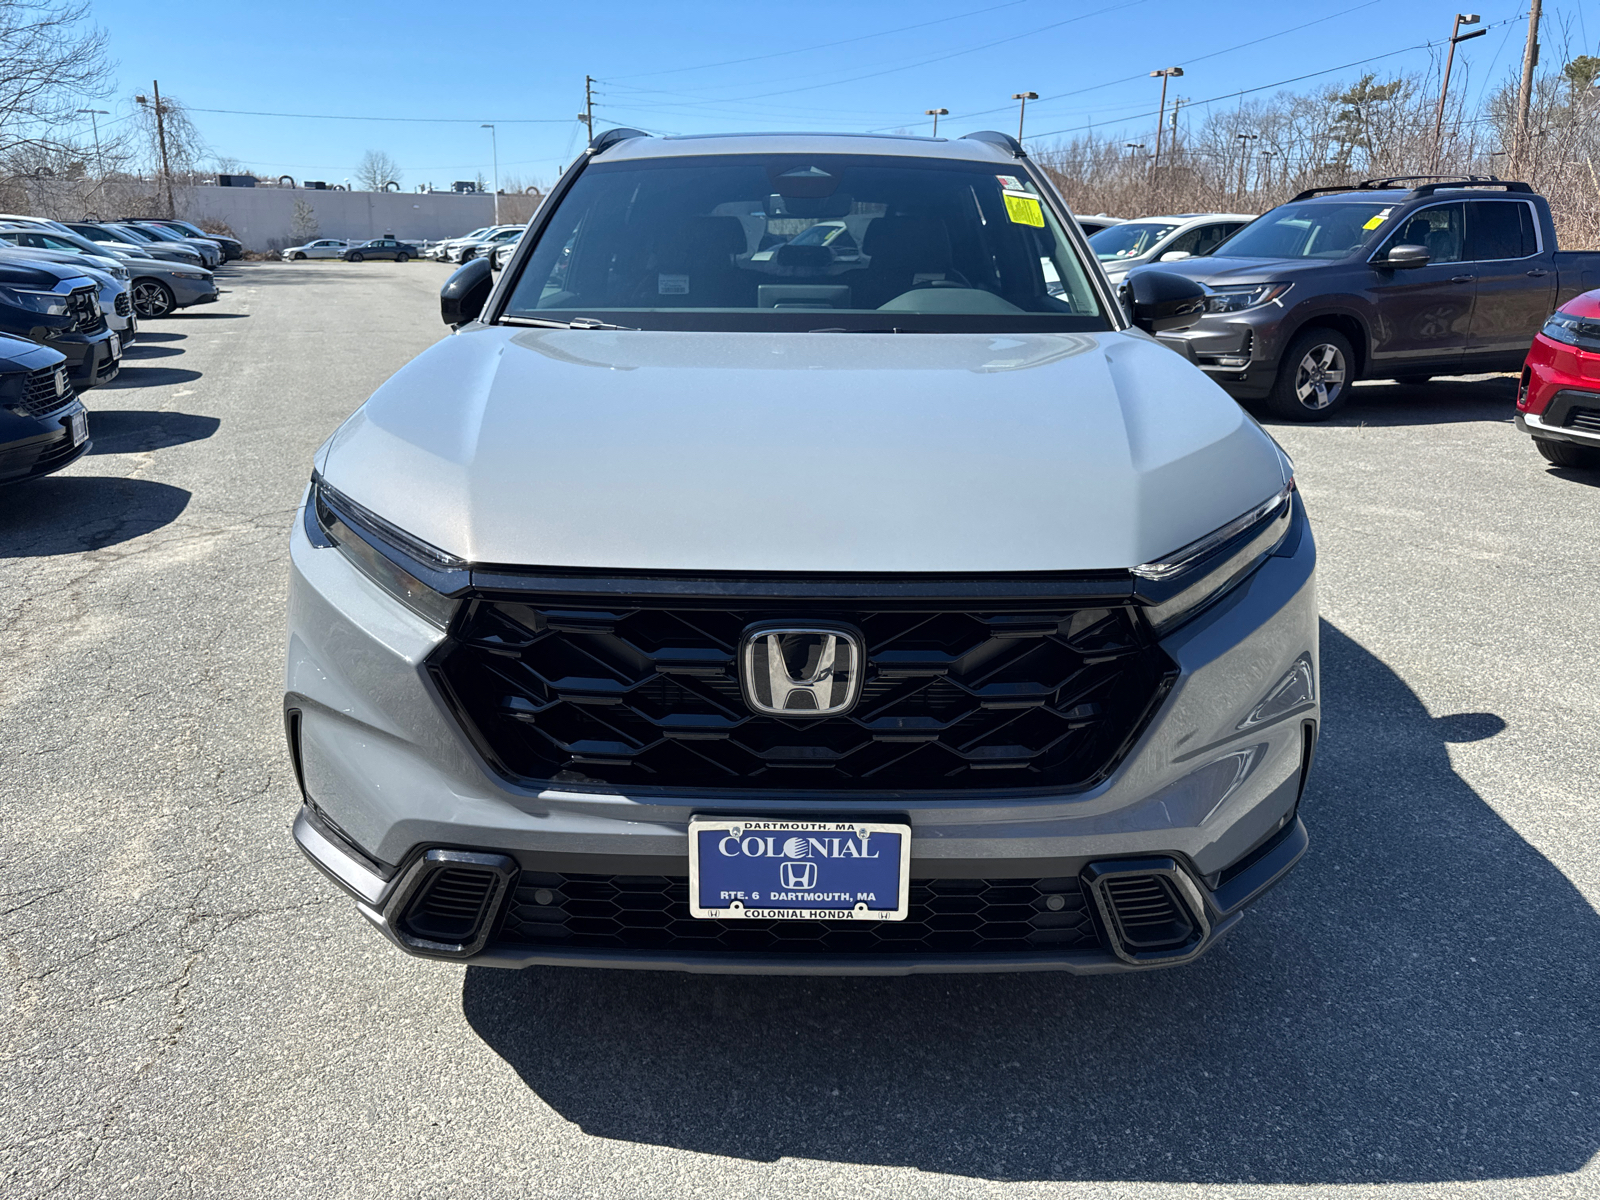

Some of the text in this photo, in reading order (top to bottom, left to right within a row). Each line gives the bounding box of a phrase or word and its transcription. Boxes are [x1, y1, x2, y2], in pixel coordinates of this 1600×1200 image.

[744, 822, 855, 831] DARTMOUTH, MA
[718, 836, 879, 859] COLONIAL
[720, 891, 876, 902] RTE. 6 DARTMOUTH, MA
[744, 909, 854, 919] COLONIAL HONDA
